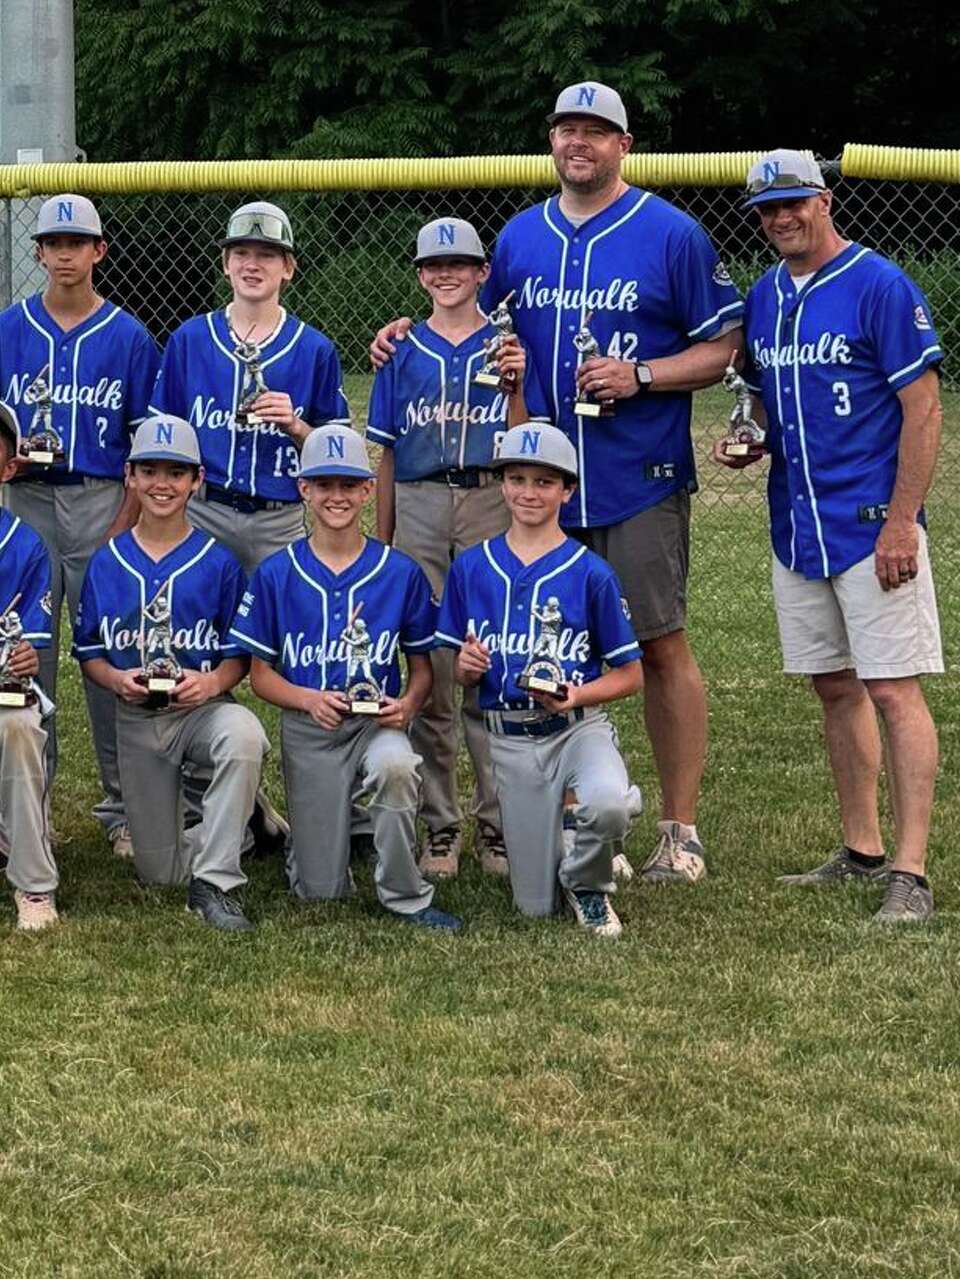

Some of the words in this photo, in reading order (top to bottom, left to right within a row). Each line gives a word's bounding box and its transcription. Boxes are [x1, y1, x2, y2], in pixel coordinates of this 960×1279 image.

[576, 87, 597, 107] N
[763, 161, 781, 182] N
[56, 201, 73, 221] N
[437, 224, 455, 245] N
[515, 277, 639, 312] Norwalk
[607, 331, 639, 363] 42
[2, 373, 124, 410] Nwalk
[832, 381, 851, 416] 3
[154, 423, 174, 445] N
[520, 431, 541, 454] N
[326, 436, 344, 458] N
[274, 446, 300, 478] 13
[99, 617, 221, 653] Noralk
